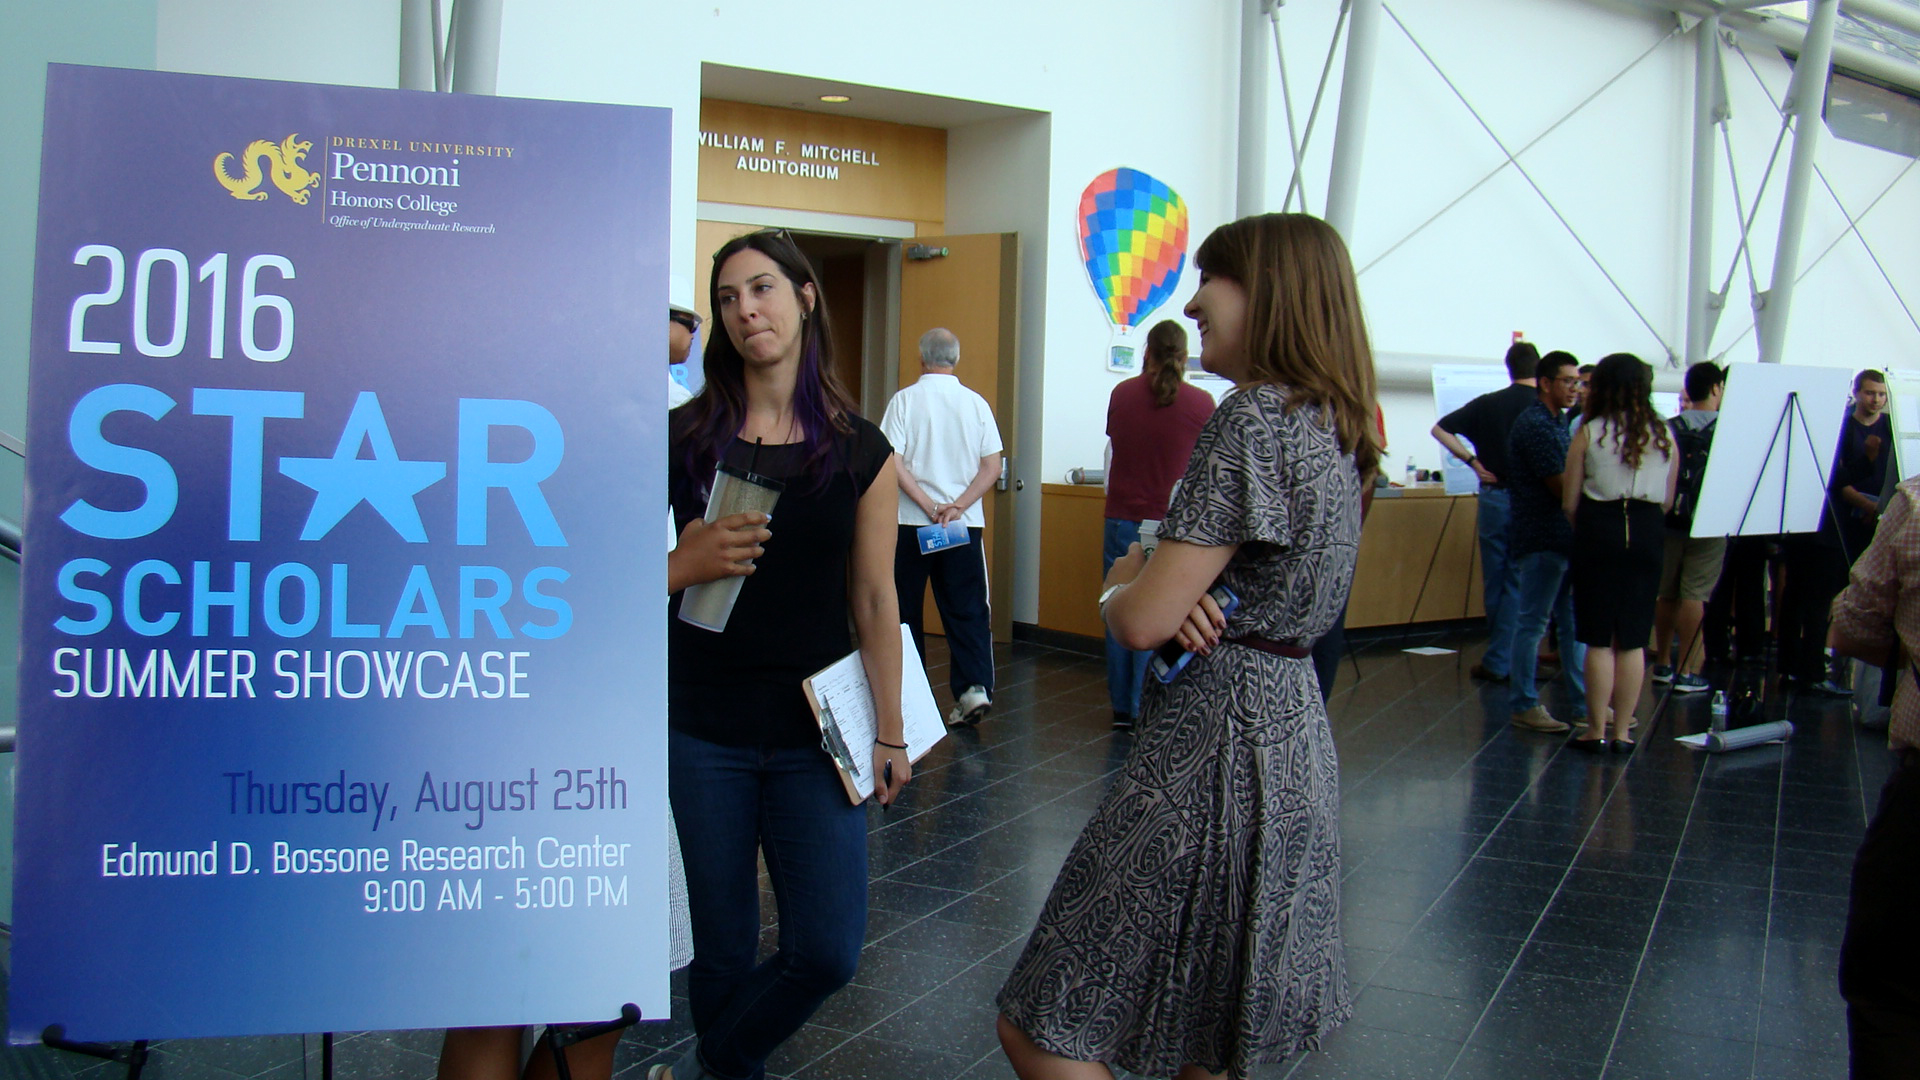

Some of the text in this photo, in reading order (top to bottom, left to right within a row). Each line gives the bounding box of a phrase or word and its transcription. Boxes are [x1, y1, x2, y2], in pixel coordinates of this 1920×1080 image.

[333, 136, 515, 158] DREXEL UNIVERSITY
[775, 140, 790, 156] F.
[802, 144, 879, 166] MITCHELL
[331, 152, 461, 187] Pennoni
[736, 156, 839, 180] AUDITORIUM
[330, 190, 458, 216] Honors College
[330, 215, 496, 234] Office of Undergraduate Research
[69, 244, 297, 363] 2016
[59, 383, 569, 547] STAR
[53, 558, 574, 640] SCHOLARS
[52, 648, 531, 700] SUMMER SHOWCASE
[223, 767, 628, 832] Thursday, August 25th
[102, 835, 632, 877] Edmund D. Bossone Research Center
[363, 880, 426, 913] 9:00
[437, 879, 483, 911] AM
[514, 876, 575, 909] 5:00
[586, 876, 629, 907] PM
